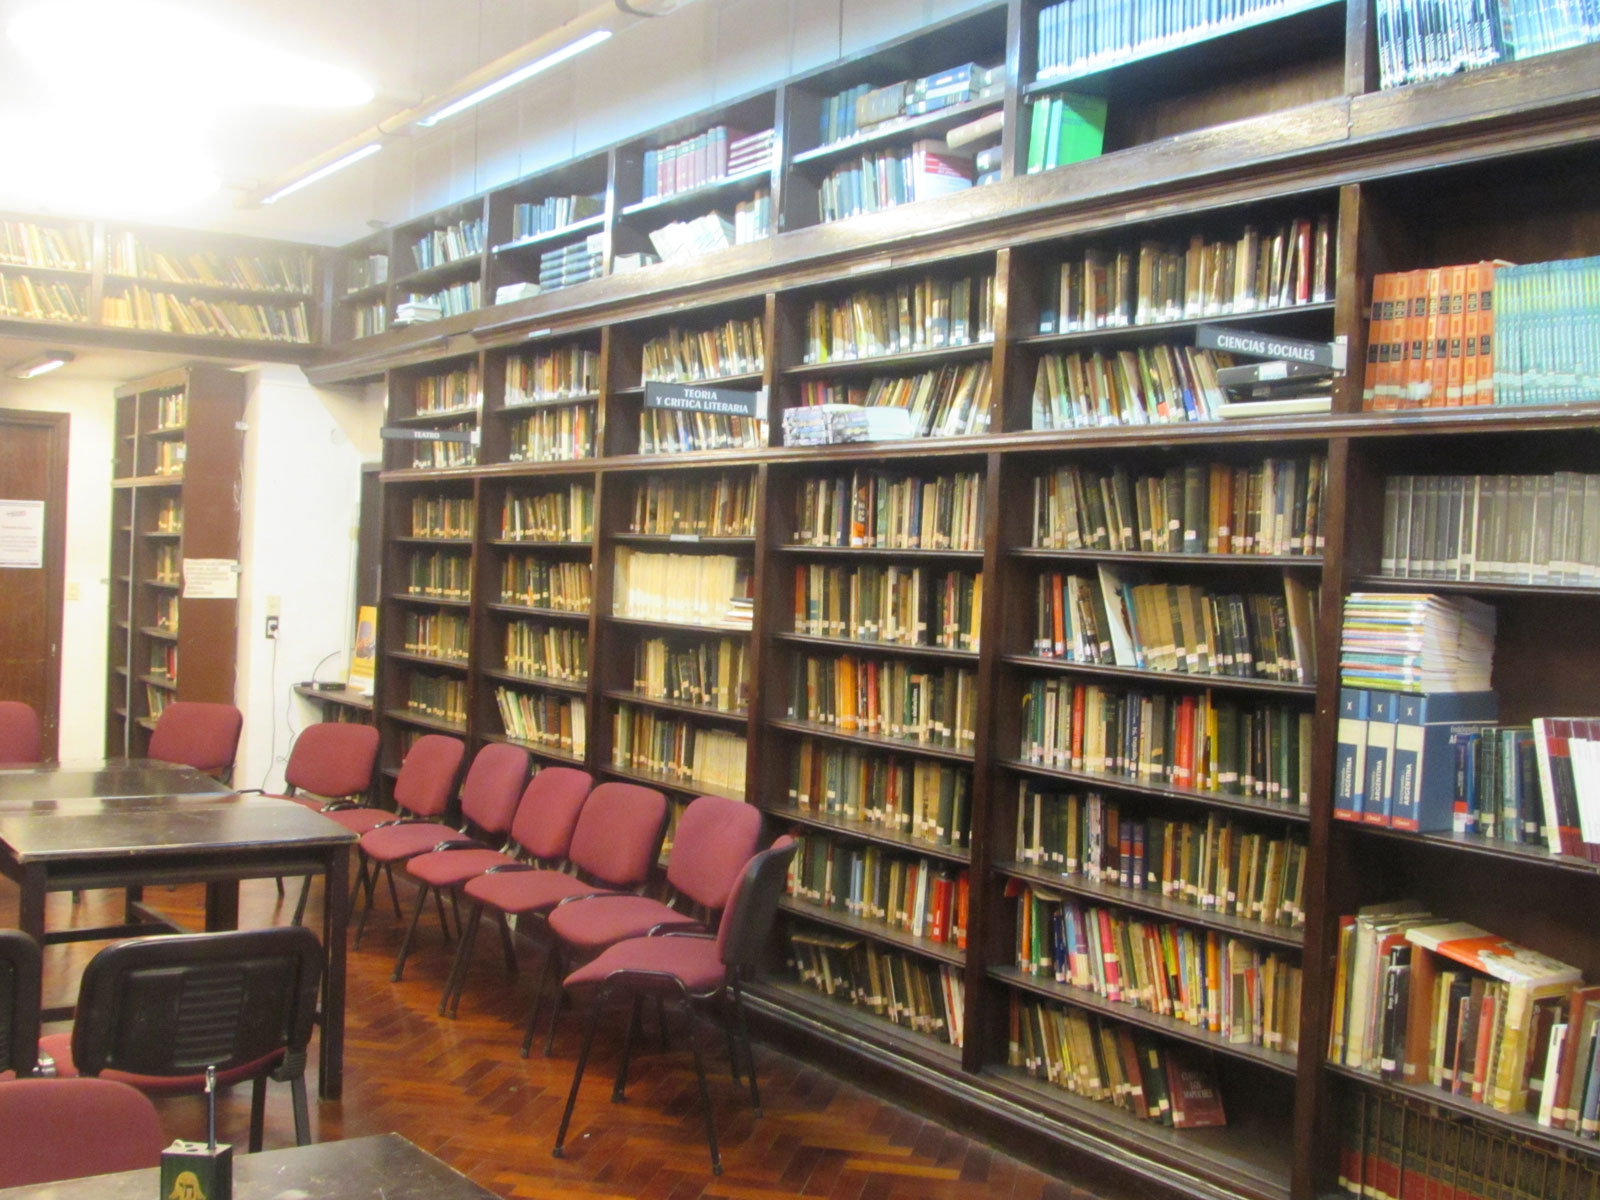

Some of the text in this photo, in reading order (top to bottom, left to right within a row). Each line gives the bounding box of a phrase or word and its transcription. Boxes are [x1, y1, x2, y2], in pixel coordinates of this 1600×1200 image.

[1217, 335, 1316, 361] CIENCIAS SOCIALES
[656, 396, 749, 414] Y CRITICA LITERARIA
[684, 388, 718, 400] TEORIA
[414, 431, 440, 439] TEATRO
[1344, 756, 1353, 798] ARGENTINA
[1374, 759, 1383, 802] ARGENTINA
[1403, 763, 1413, 806] ARGENTINA
